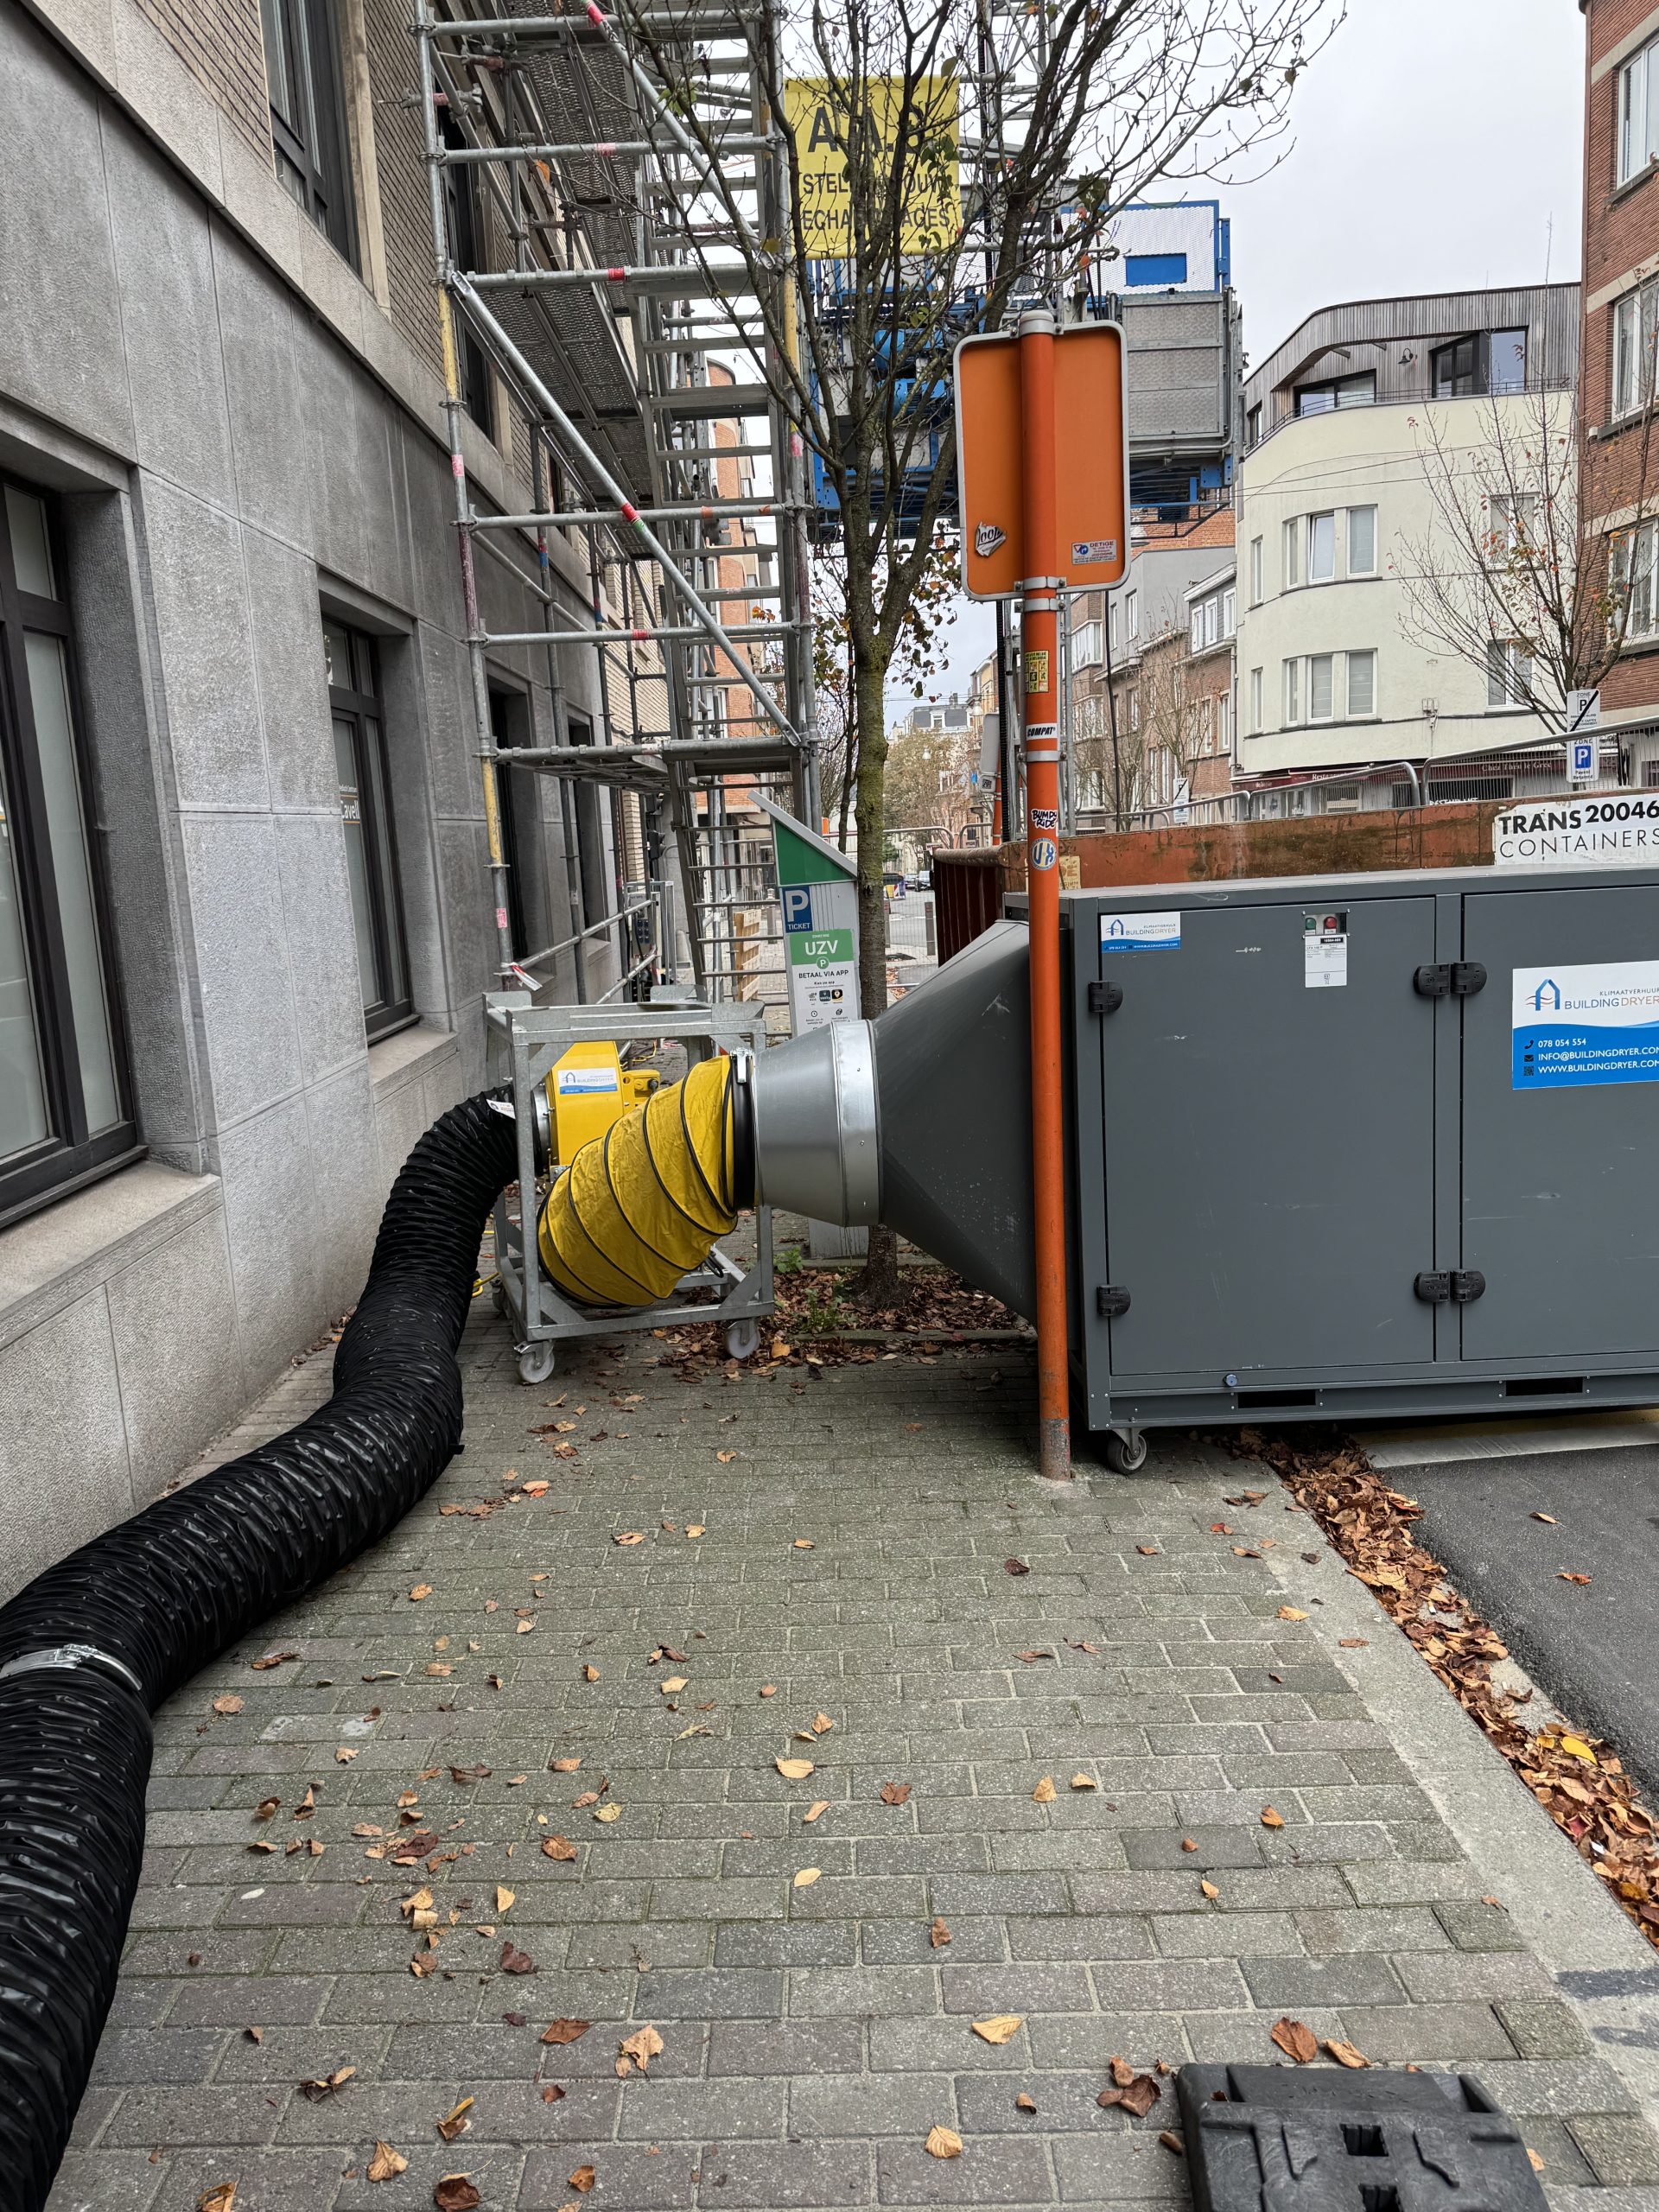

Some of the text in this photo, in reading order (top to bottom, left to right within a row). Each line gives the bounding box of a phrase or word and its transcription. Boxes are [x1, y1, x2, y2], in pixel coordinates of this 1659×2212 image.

[803, 208, 951, 230] ECHAAGES
[1577, 748, 1589, 766] P
[1498, 800, 1659, 836] TRANS 20046
[1499, 828, 1659, 858] CONTAINERS
[785, 890, 809, 922] P
[787, 922, 810, 931] TICKET
[1125, 927, 1176, 936] BUILDINGDRYER
[804, 939, 838, 956] UZV
[1565, 995, 1659, 1009] BUILDINGDRYER
[1538, 1039, 1553, 1048] 078
[1573, 1038, 1586, 1046] 554
